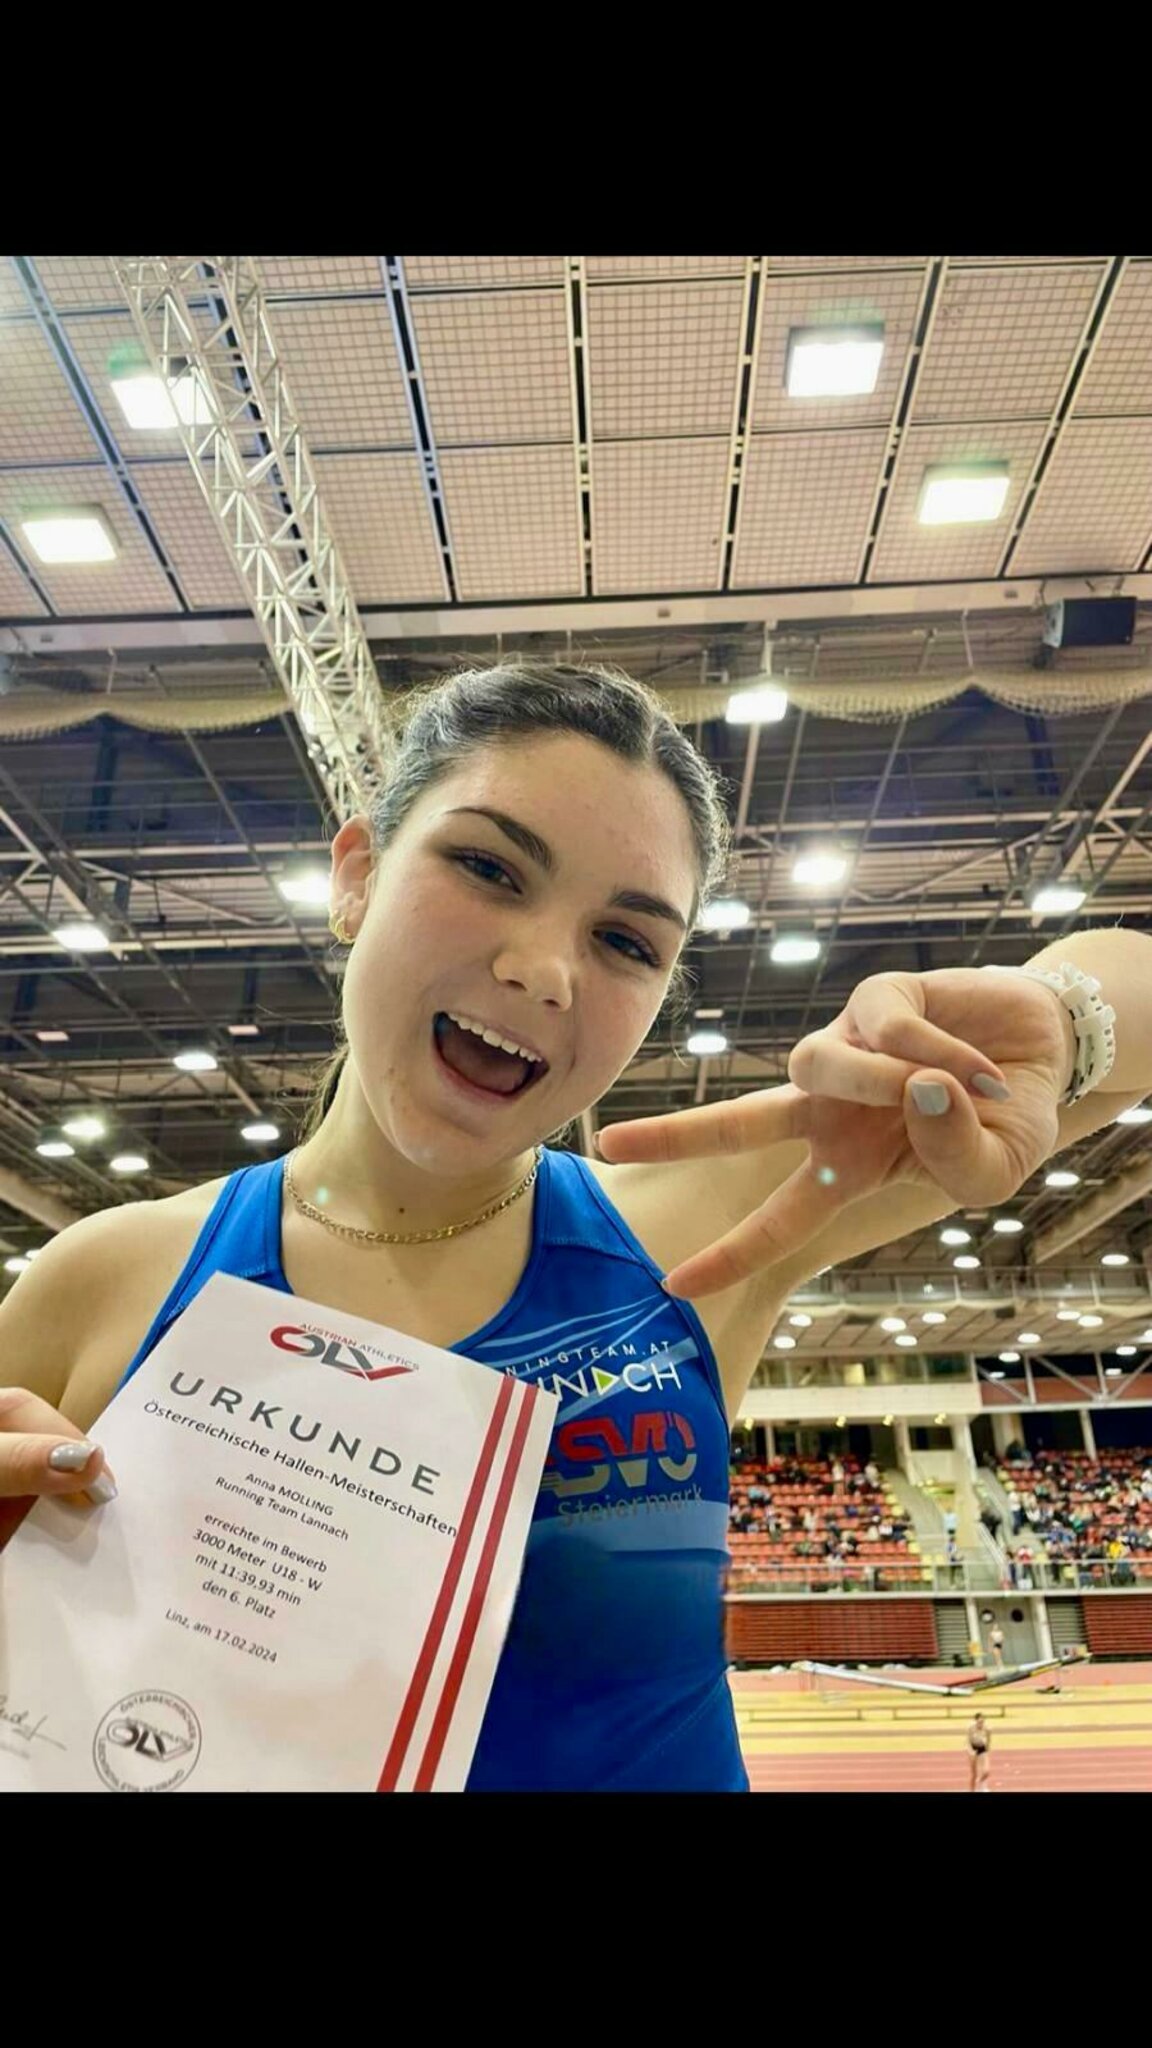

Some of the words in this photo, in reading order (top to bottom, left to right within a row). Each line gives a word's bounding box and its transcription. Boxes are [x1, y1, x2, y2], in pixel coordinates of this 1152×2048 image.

[300, 1323, 357, 1347] AUSTRIAN
[359, 1343, 420, 1371] ATHLETICS
[170, 1371, 441, 1496] URKUNDE
[144, 1399, 270, 1457] Österreichische
[273, 1450, 457, 1538] Hallen-Meisterschaften
[246, 1473, 276, 1492] Anna
[278, 1486, 334, 1516] MOLLING
[215, 1476, 265, 1507] Running
[267, 1498, 298, 1519] Team
[300, 1512, 349, 1541] Lannach
[558, 1482, 703, 1528] Steiermark
[193, 1528, 226, 1550] 3000
[227, 1543, 267, 1568] Meter
[271, 1562, 298, 1582] U18
[307, 1576, 323, 1592] W
[205, 1513, 260, 1543] erreichte
[262, 1537, 278, 1551] im
[281, 1545, 328, 1573] Bewerb
[195, 1553, 218, 1571] mit
[219, 1562, 276, 1595] 11:39,93
[276, 1587, 302, 1607] min
[202, 1579, 228, 1599] den
[229, 1591, 241, 1604] 6.
[245, 1596, 276, 1619] Platz
[165, 1608, 190, 1629] Linz,
[193, 1622, 212, 1636] am
[214, 1628, 278, 1664] 17.02.2024
